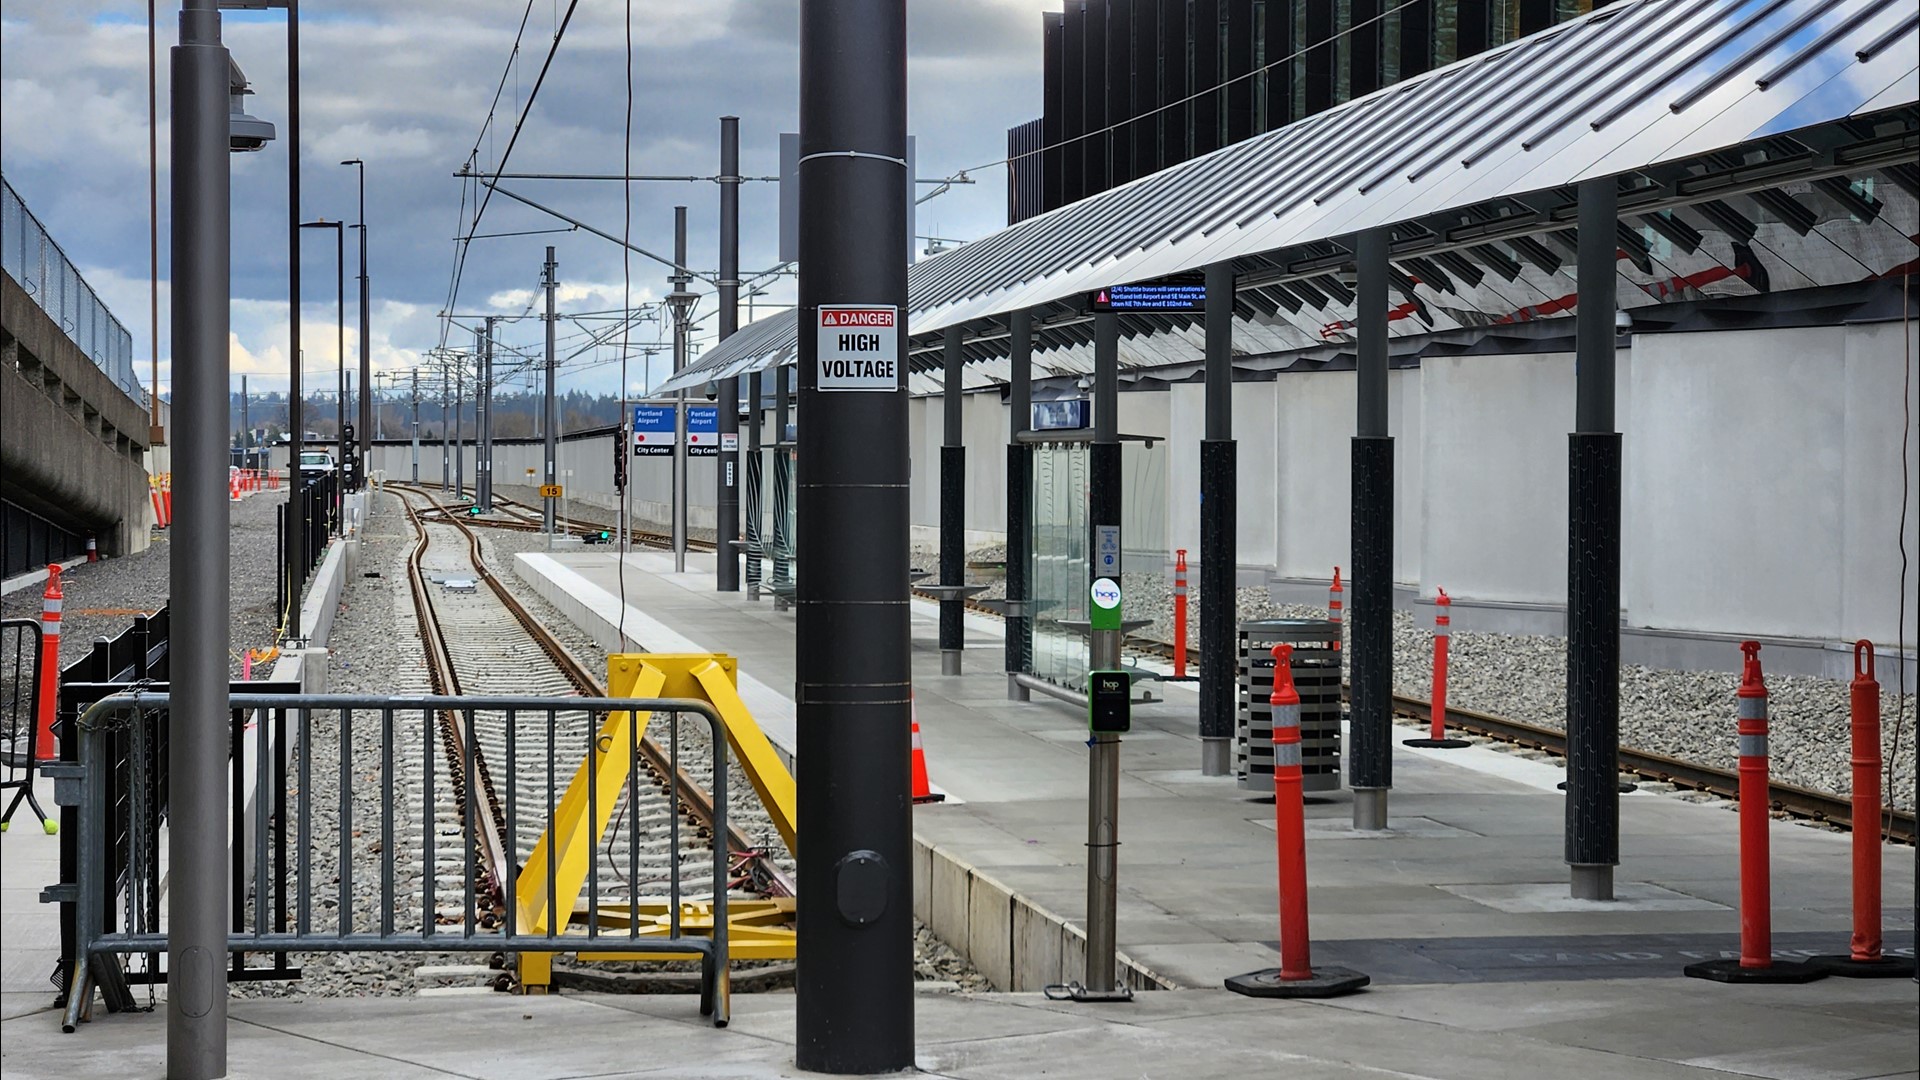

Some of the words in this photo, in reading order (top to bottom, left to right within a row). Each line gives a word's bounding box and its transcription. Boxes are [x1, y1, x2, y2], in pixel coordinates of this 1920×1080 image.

[840, 313, 892, 325] DANGER
[838, 334, 880, 351] HIGH
[822, 360, 894, 378] VOLTAGE
[1095, 589, 1118, 601] hop
[1103, 680, 1120, 690] hop
